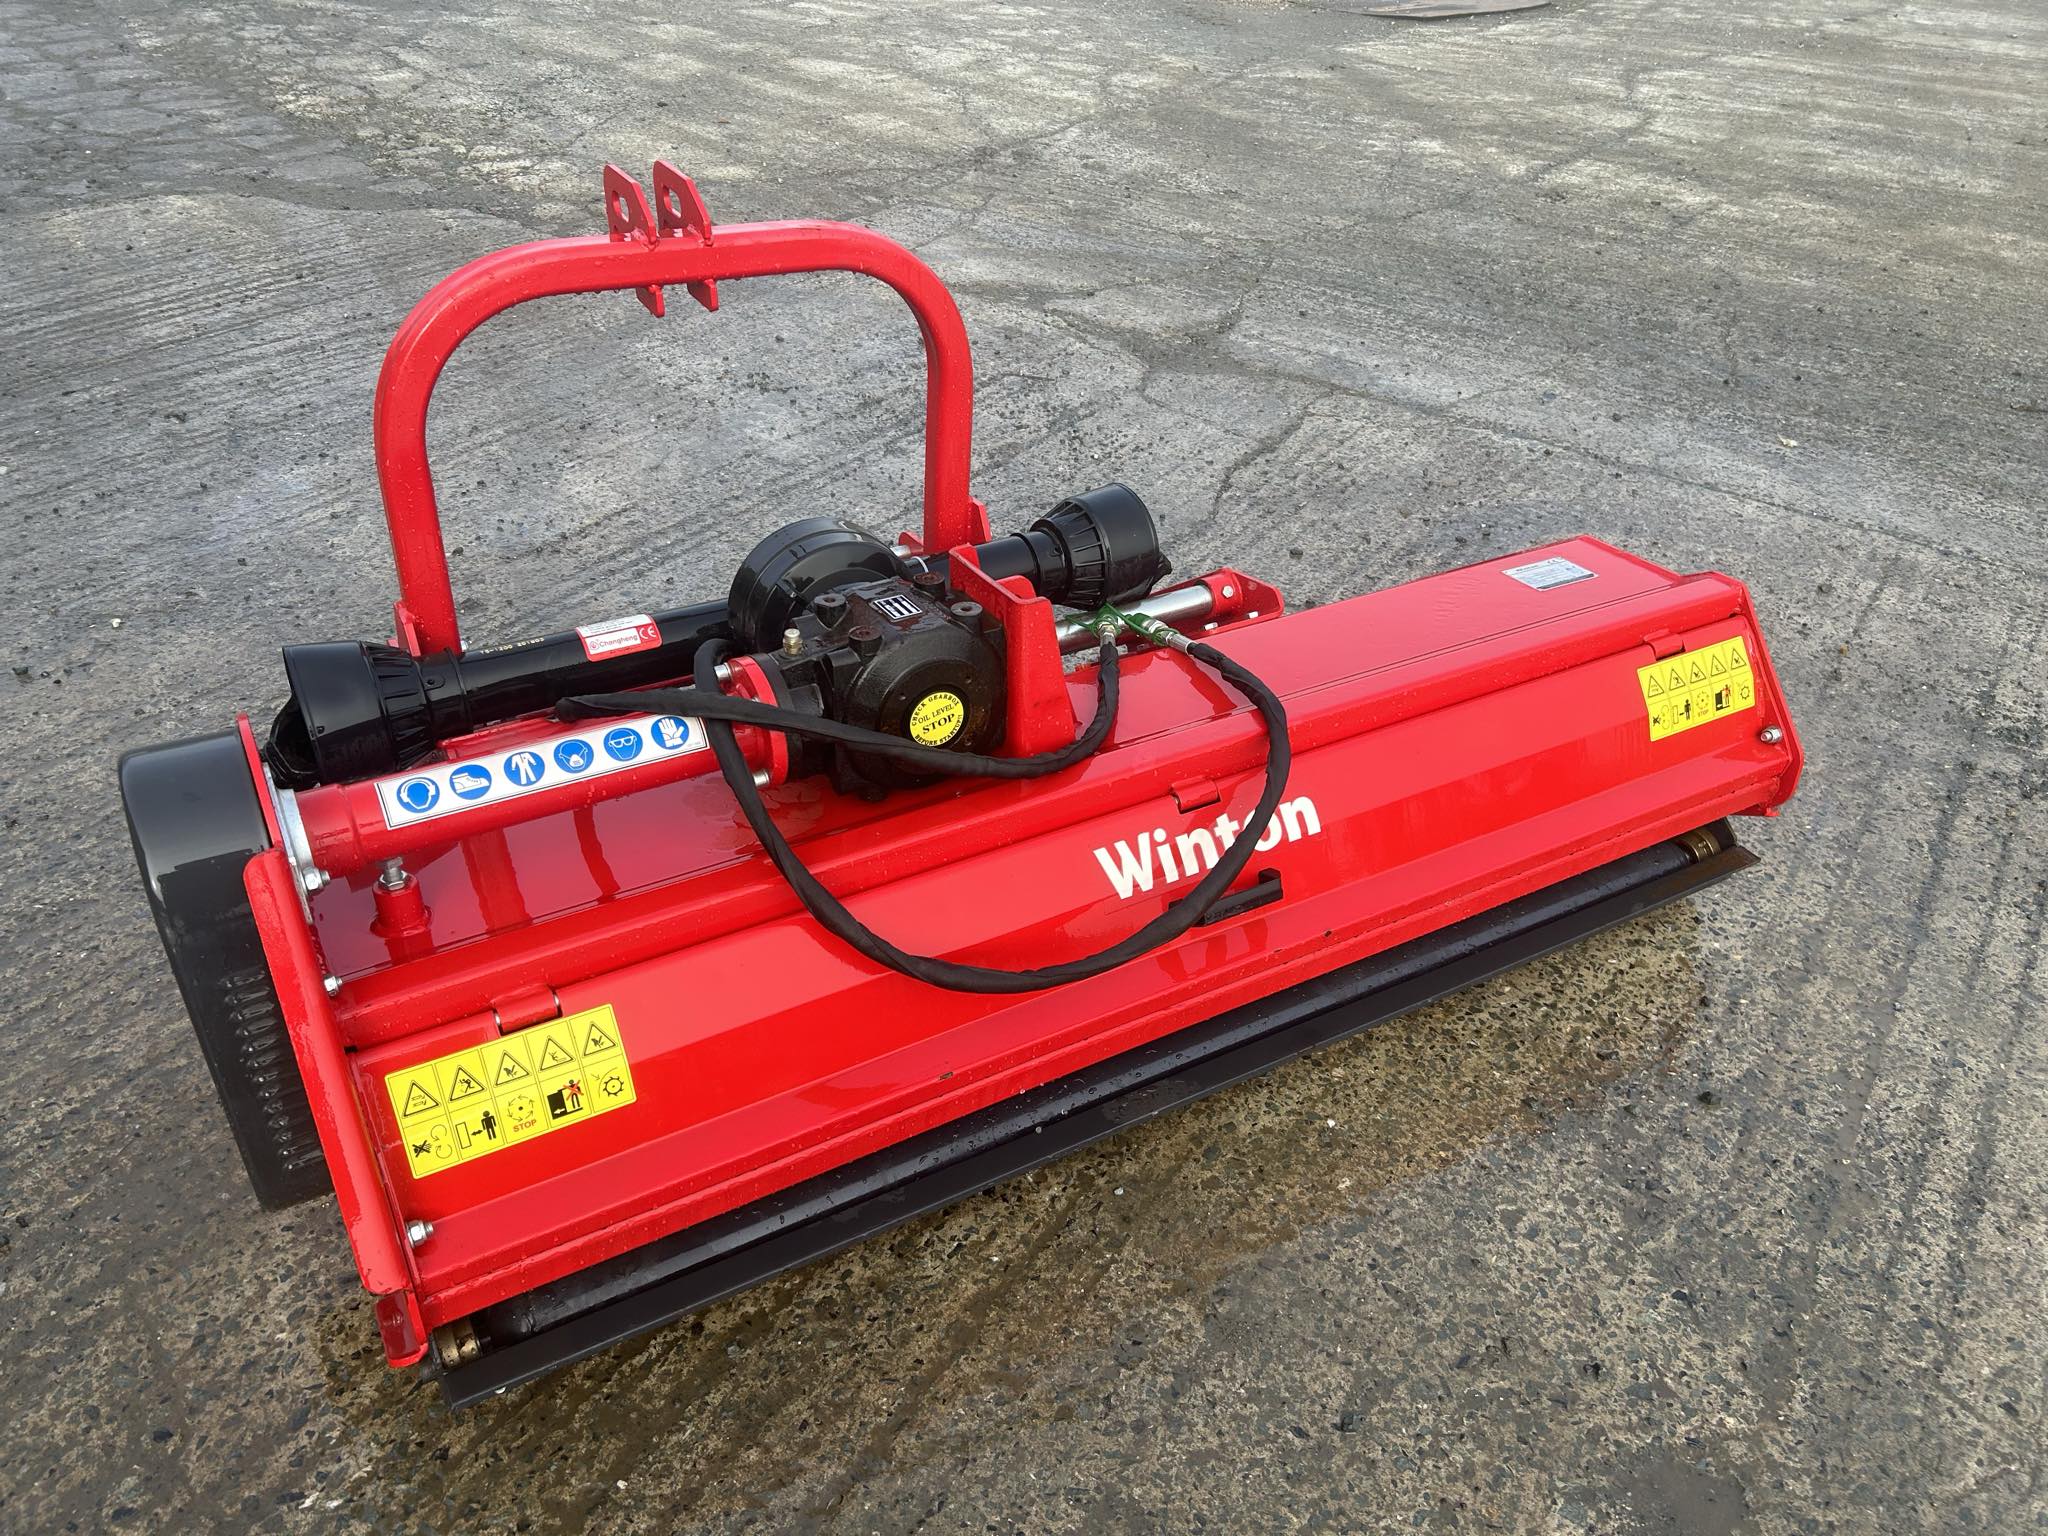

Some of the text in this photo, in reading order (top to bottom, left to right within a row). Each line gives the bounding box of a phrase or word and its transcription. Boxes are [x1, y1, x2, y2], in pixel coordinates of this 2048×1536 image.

[599, 635, 638, 647] Changheng
[911, 694, 960, 726] CHECK GEARBOX
[918, 704, 955, 724] OIL LEVEL
[922, 713, 955, 734] STOP
[914, 734, 938, 746] BEFORE
[513, 1119, 537, 1133] STOP
